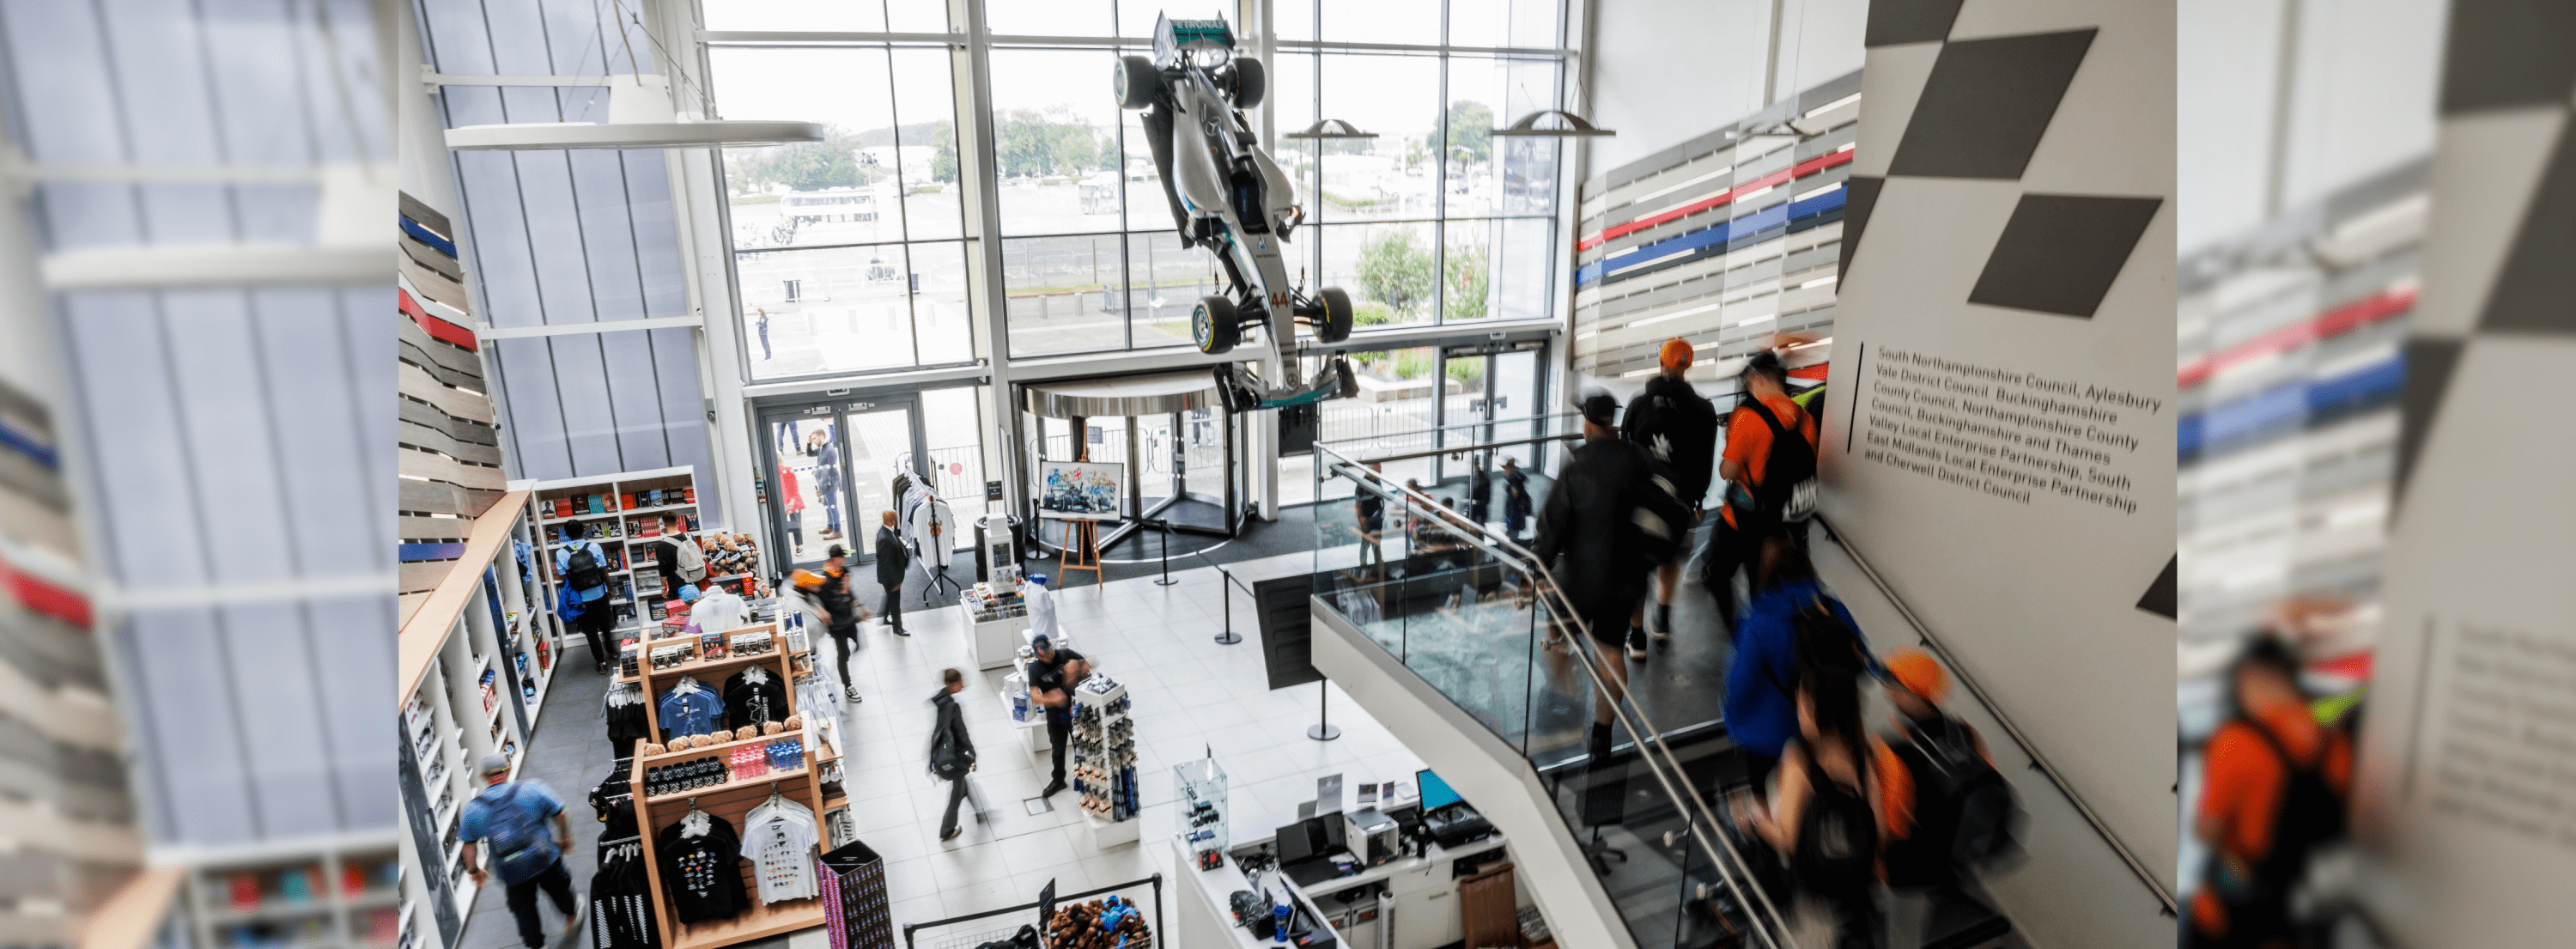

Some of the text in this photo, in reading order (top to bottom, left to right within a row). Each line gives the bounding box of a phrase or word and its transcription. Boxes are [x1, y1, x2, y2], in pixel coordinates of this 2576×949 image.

[1272, 291, 1289, 308] 44
[1876, 362, 2117, 425] Vale District Council Buckinghamshire
[1879, 344, 2161, 416] South Northamptonshire Council, Aylesbury
[1872, 396, 2111, 465] Council, Buckinghamshire and Thames
[1874, 379, 2139, 453] County Council, Northamptonshire County
[1865, 448, 2031, 506] and Cherwell District Council
[1868, 429, 2137, 516] East Midlands Local Enterprise Partnership
[1869, 412, 2130, 491] Valley Local Enterprise Partnership, South
